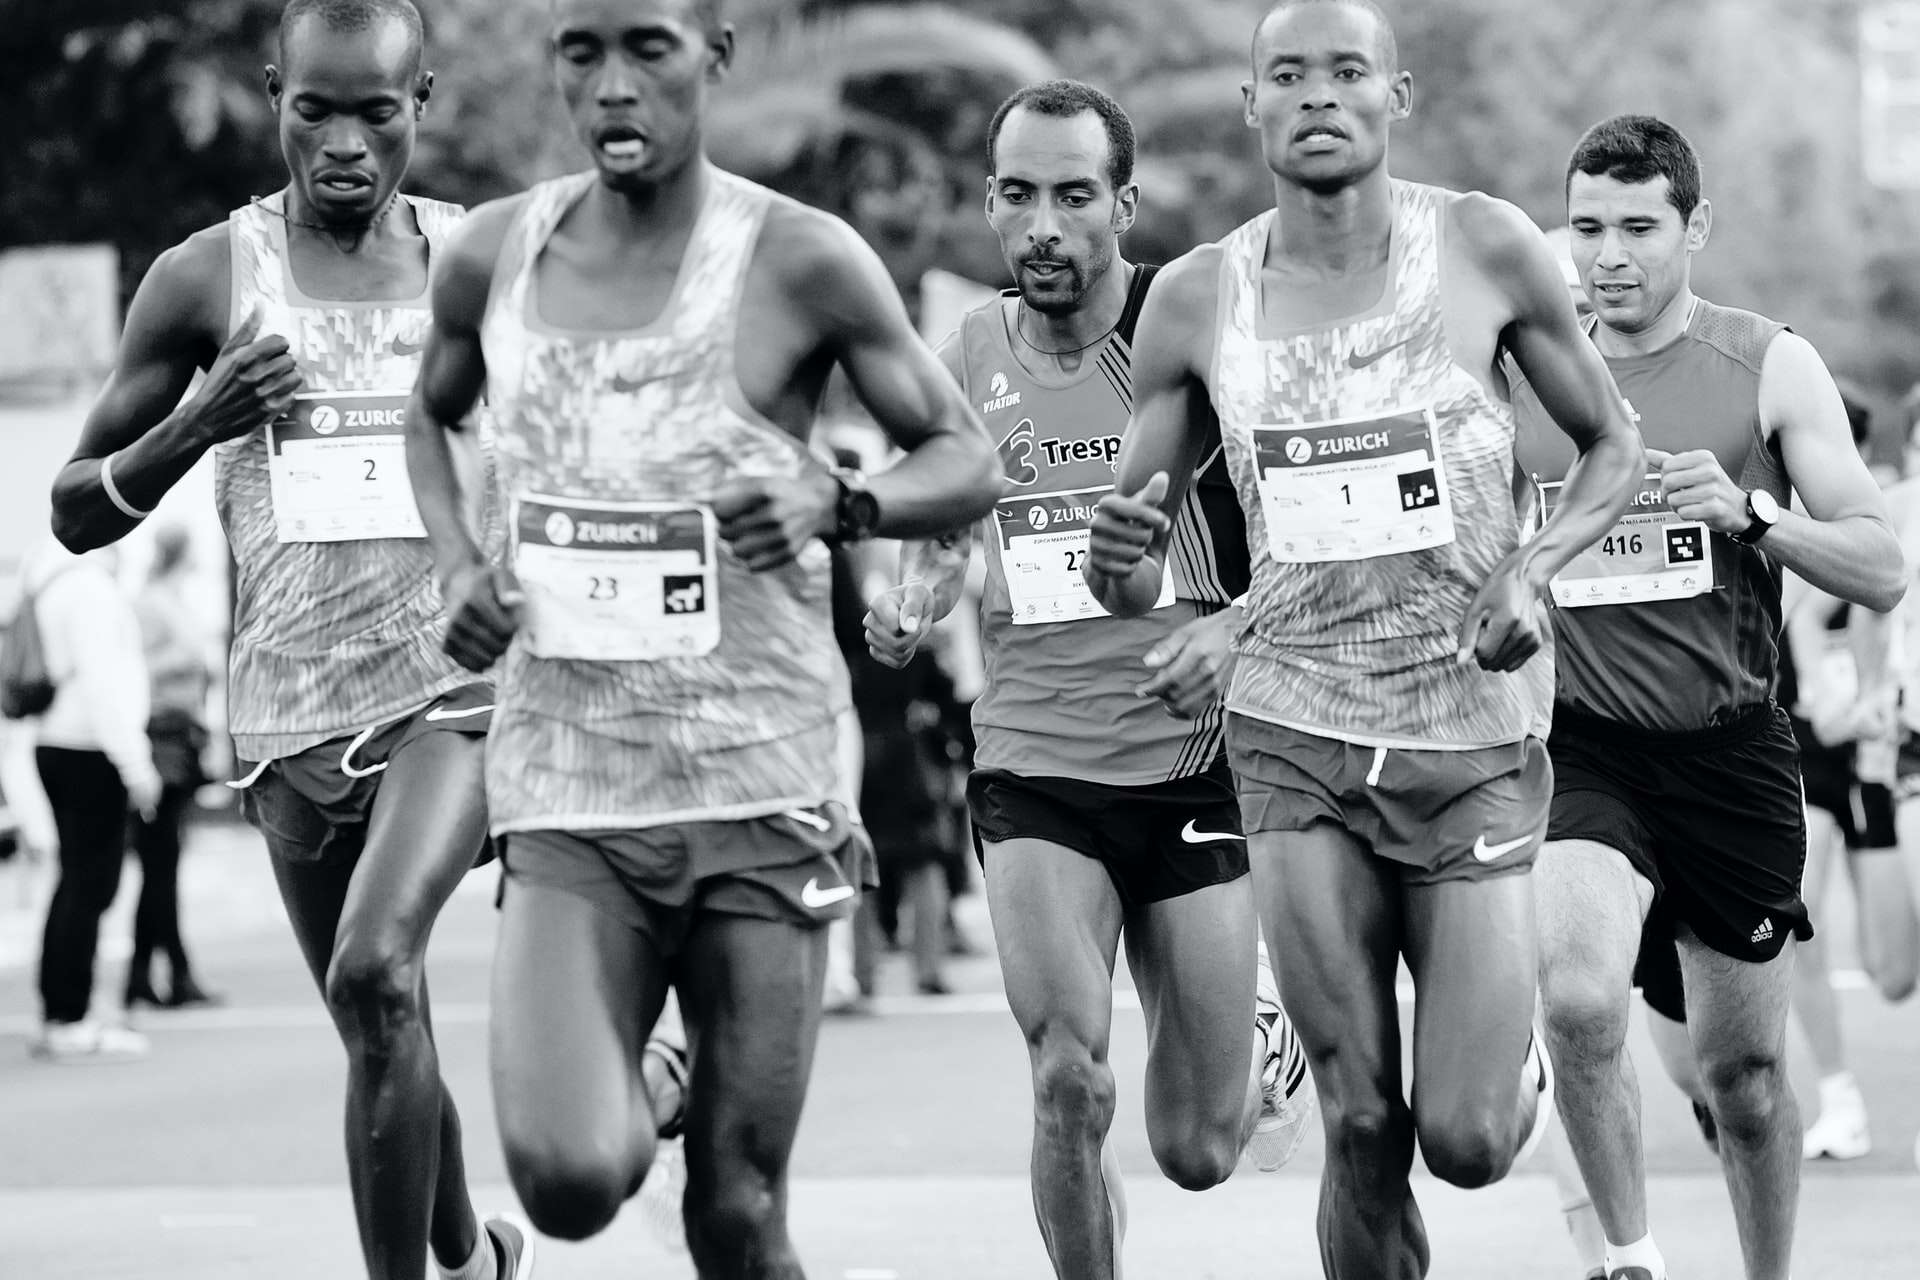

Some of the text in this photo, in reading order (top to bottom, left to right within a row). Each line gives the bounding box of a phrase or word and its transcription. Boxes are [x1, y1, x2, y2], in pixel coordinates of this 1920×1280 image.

[983, 392, 1021, 413] VIATOR
[345, 409, 405, 427] ZURIC
[1039, 435, 1122, 467] Tresp
[1316, 431, 1389, 456] ZURICH
[362, 458, 378, 481] 2
[1340, 483, 1351, 505] 1
[1630, 490, 1662, 506] ICH
[1052, 504, 1100, 523] ZURIC
[576, 521, 658, 544] ZURICH
[1602, 534, 1643, 556] 416
[588, 576, 618, 600] 23
